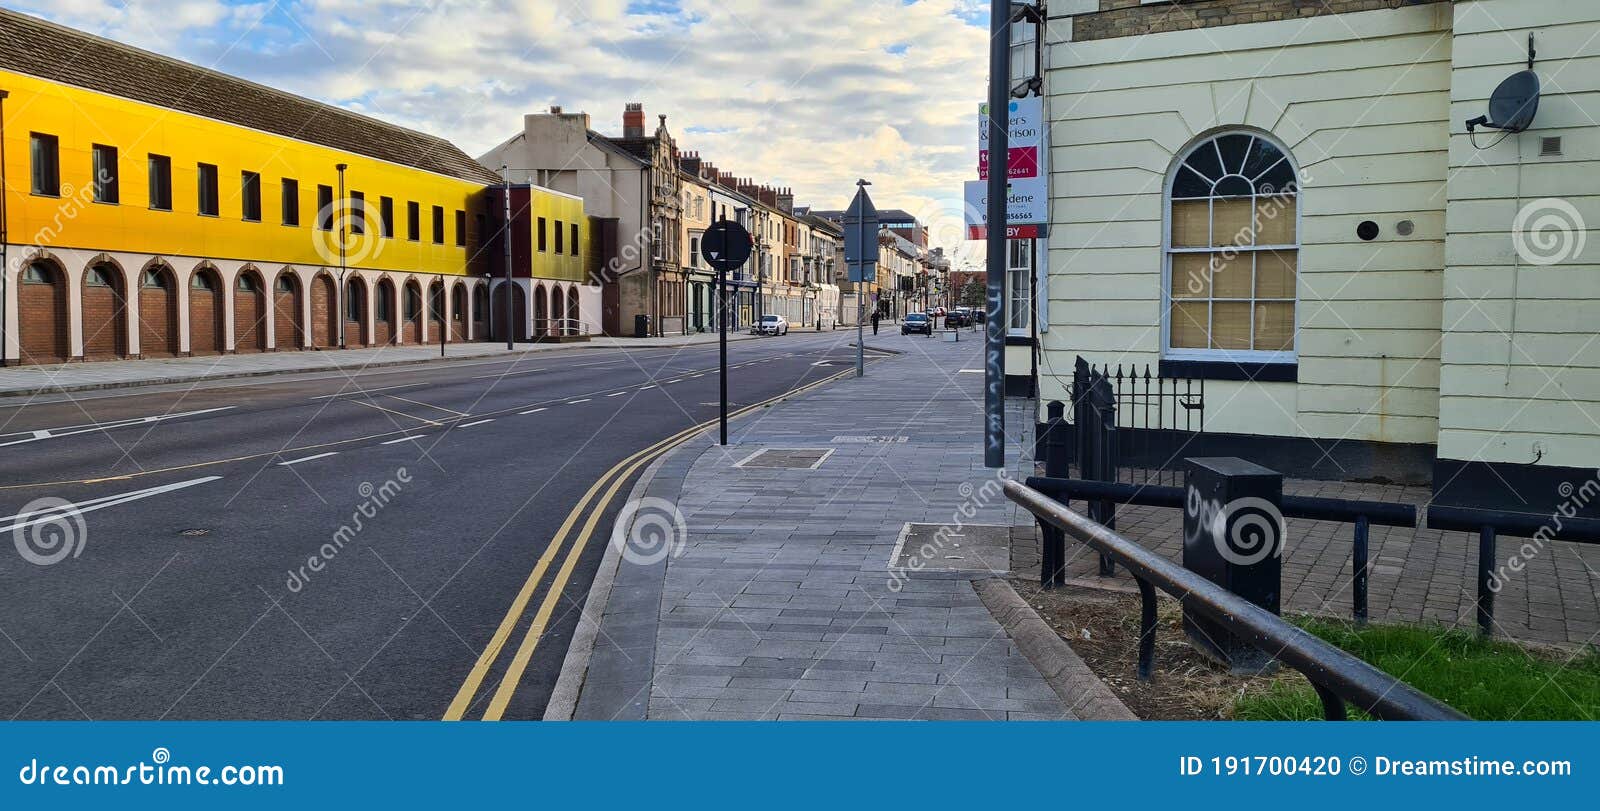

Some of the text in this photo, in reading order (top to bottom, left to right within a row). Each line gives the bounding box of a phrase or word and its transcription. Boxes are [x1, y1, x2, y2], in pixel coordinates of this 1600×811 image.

[980, 116, 1027, 128] mers
[980, 130, 988, 141] &
[981, 194, 1034, 205] cdene
[1006, 227, 1020, 237] BY
